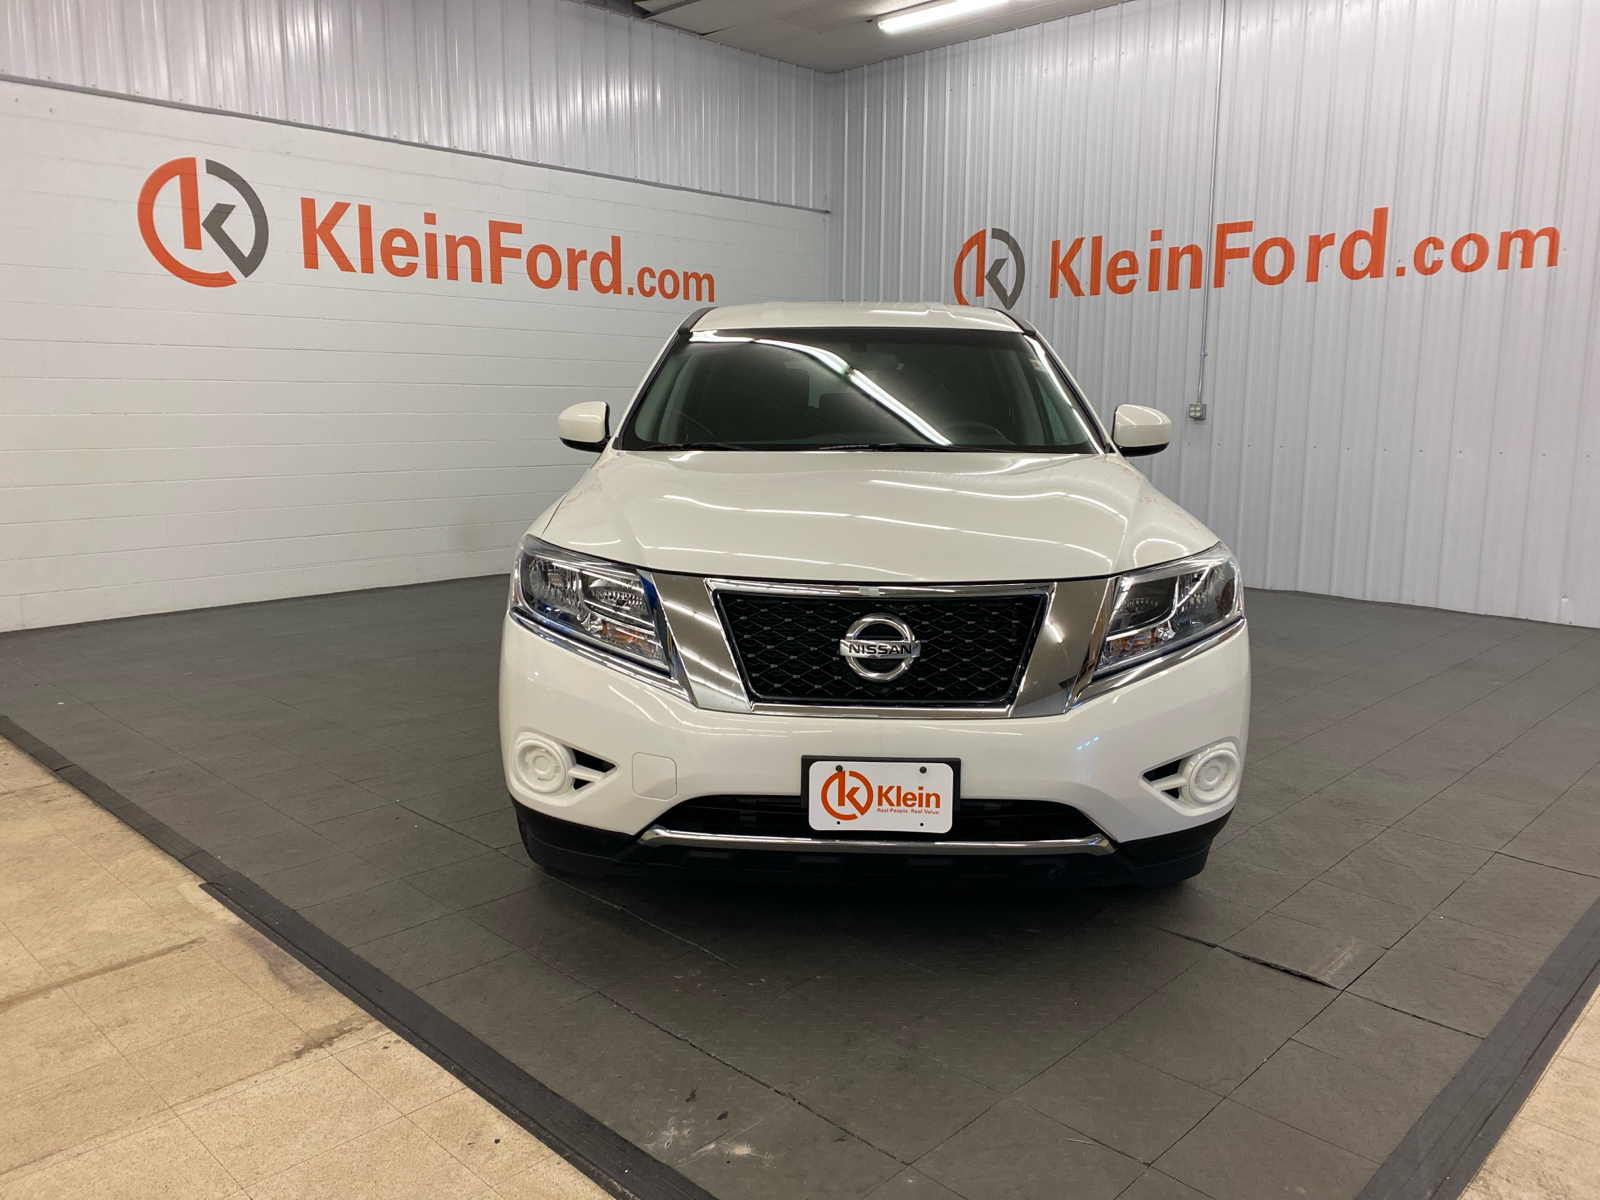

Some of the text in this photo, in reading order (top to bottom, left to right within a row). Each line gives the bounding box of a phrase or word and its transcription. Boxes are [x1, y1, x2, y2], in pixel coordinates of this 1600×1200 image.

[301, 197, 714, 302] KleinFord.com
[1049, 207, 1559, 298] KleinFord.com
[848, 643, 912, 655] NISSAN
[877, 785, 940, 808] Klein
